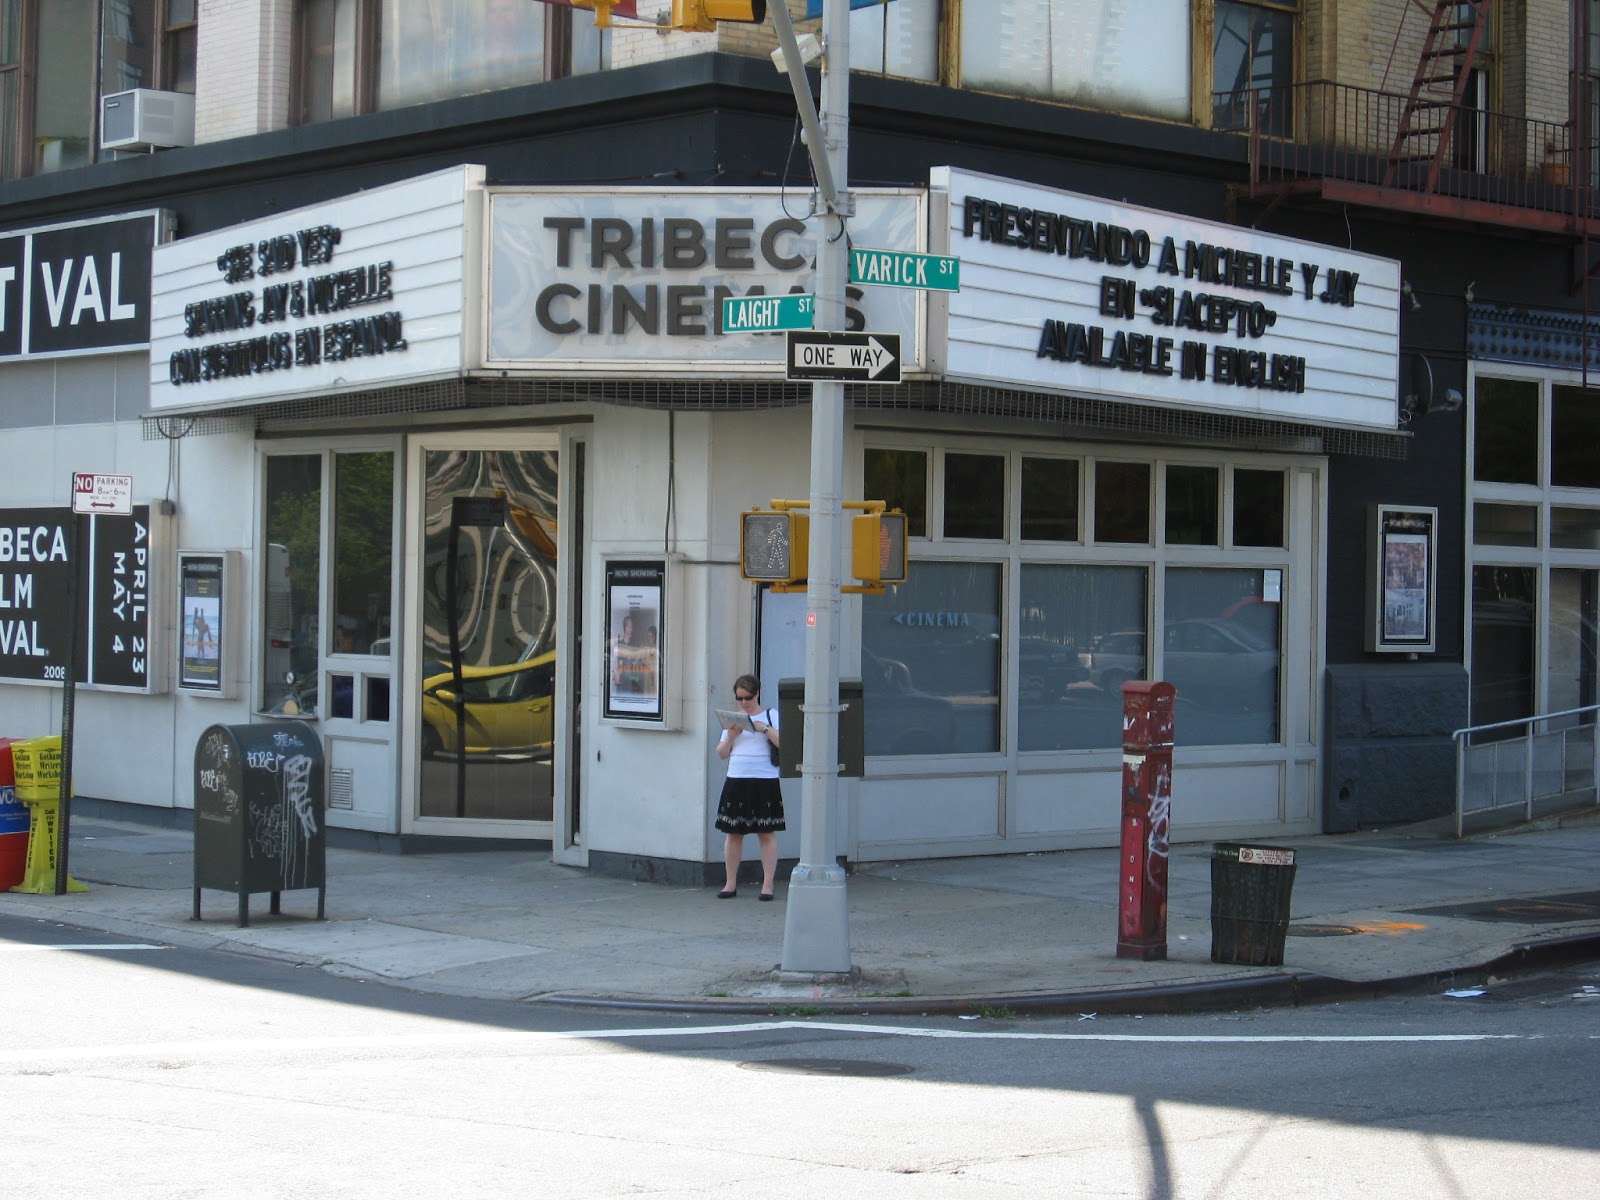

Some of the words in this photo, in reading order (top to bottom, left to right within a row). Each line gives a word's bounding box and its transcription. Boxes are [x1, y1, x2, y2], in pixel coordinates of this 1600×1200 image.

[543, 217, 852, 269] TRIBEC
[963, 196, 1150, 268] PRESENTANDO
[1158, 236, 1179, 275] A
[1186, 240, 1293, 296] MICHELLE
[1302, 262, 1318, 300] Y
[1320, 268, 1359, 307] JAY
[307, 261, 393, 316] MICHELLE
[856, 252, 927, 285] VARICK
[940, 260, 954, 275] ST
[535, 282, 865, 336] CINES
[728, 300, 781, 328] LAIGHT
[798, 298, 811, 312] ST
[1101, 275, 1136, 320] EN
[295, 326, 320, 366] EN
[803, 346, 835, 366] ONE
[850, 348, 883, 367] WAY
[1038, 319, 1174, 376] AVAILABLE
[1181, 340, 1208, 381] IN
[1214, 345, 1306, 394] ENGLISH
[76, 477, 93, 491] NO
[96, 477, 129, 486] PARKING
[113, 552, 126, 622] MAY
[132, 521, 147, 622] APRIL
[630, 570, 658, 578] SHOWING
[906, 611, 970, 627] CINEMA
[112, 634, 125, 654] 4
[132, 636, 145, 674] 23
